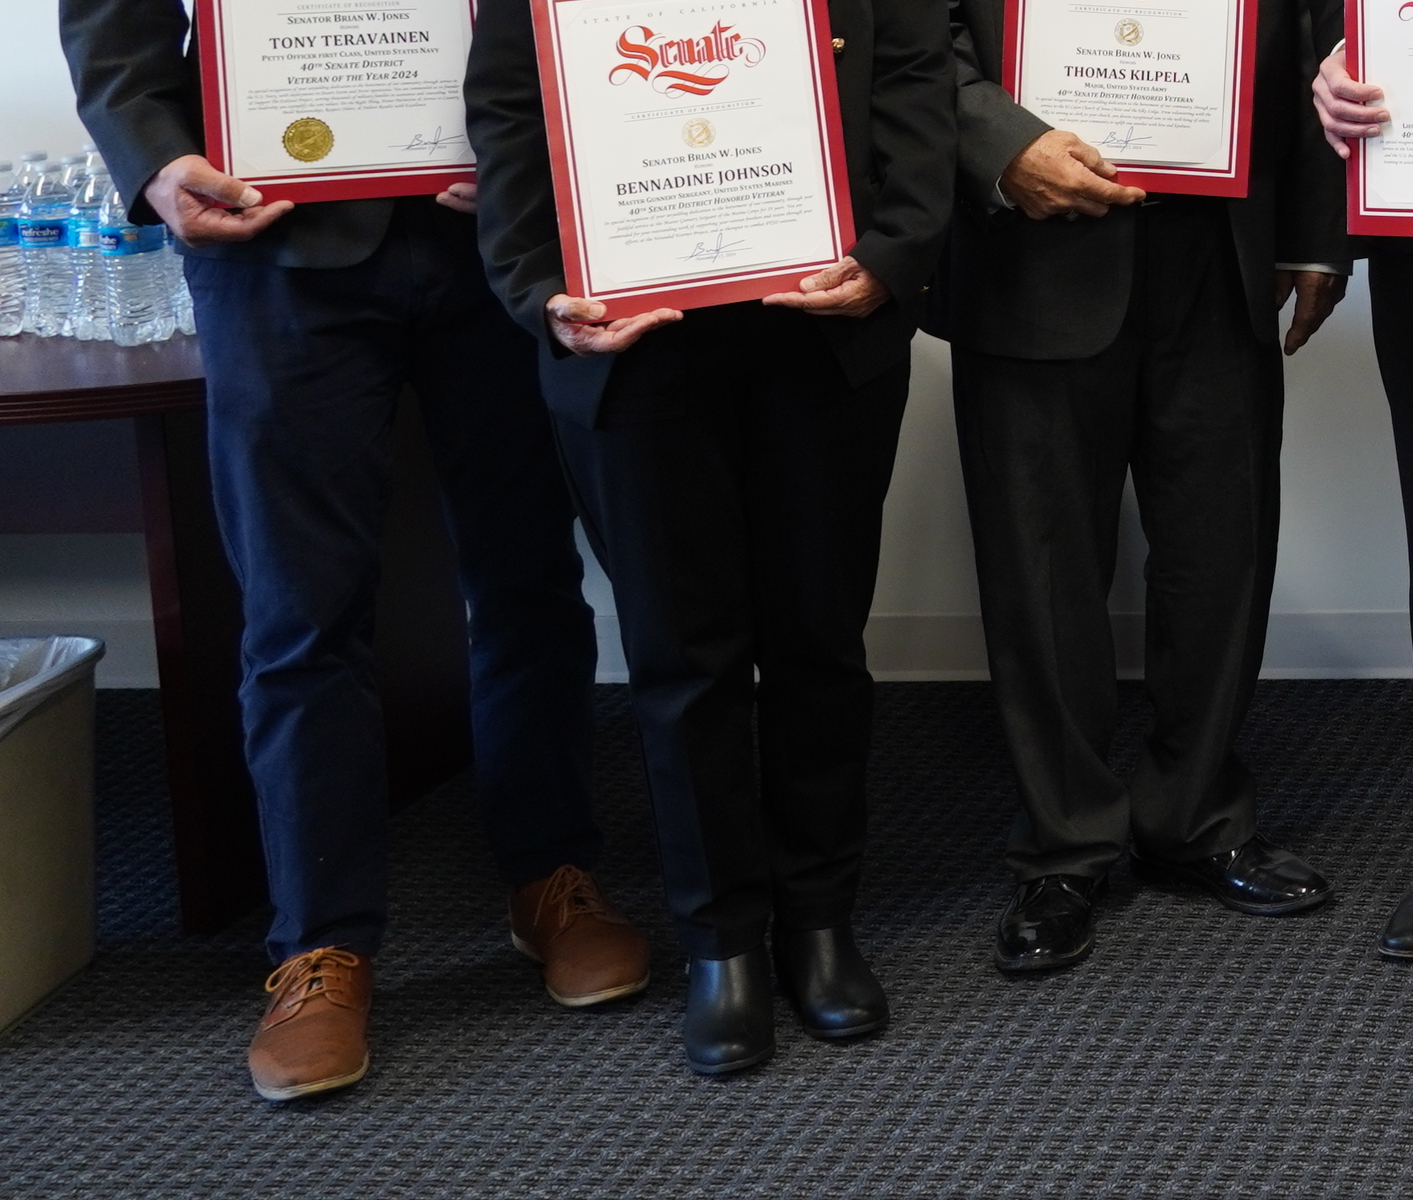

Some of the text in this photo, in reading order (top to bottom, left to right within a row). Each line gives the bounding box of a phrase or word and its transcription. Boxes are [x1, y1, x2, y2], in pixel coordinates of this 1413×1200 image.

[287, 12, 410, 25] SENATOR BRIAN W. JONES
[268, 30, 430, 50] TONY TERAVAINEN
[609, 19, 766, 87] Senate
[1076, 46, 1181, 61] SENATOR BRIAN W. JONES
[1064, 65, 1190, 84] THOMAS KILPELA
[642, 146, 763, 168] SENATOR BRIAN W. JONES
[616, 161, 793, 196] BENNADINE JOHNSON
